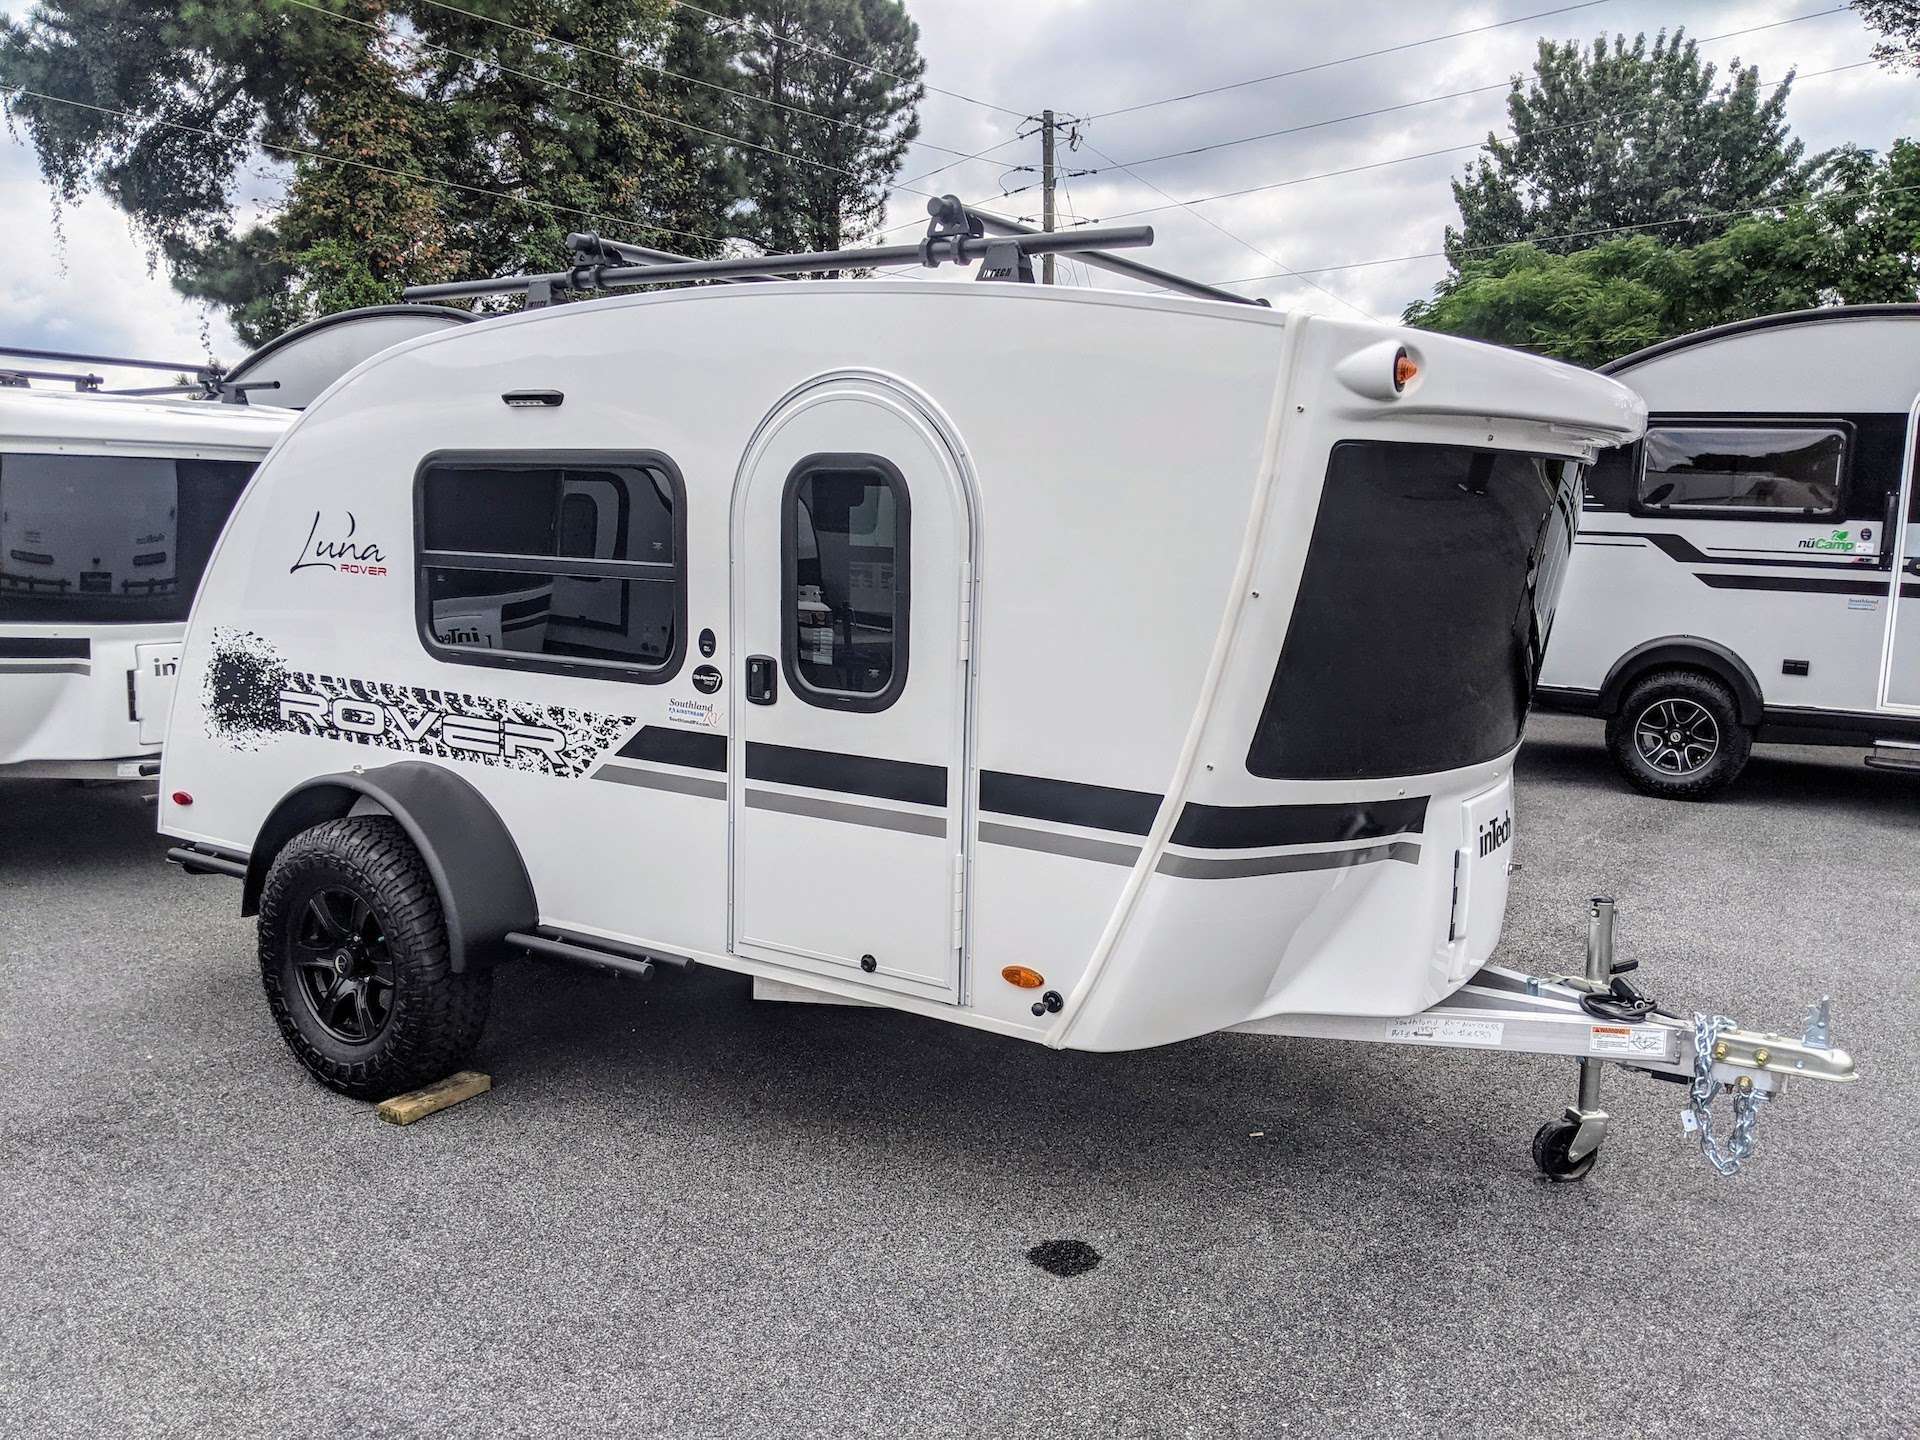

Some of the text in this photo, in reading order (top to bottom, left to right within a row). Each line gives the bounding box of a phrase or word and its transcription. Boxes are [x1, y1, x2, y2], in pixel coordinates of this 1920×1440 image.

[290, 510, 386, 574] Luna
[340, 563, 387, 576] ROVER
[669, 697, 714, 712] Southland
[279, 690, 568, 767] ROVER
